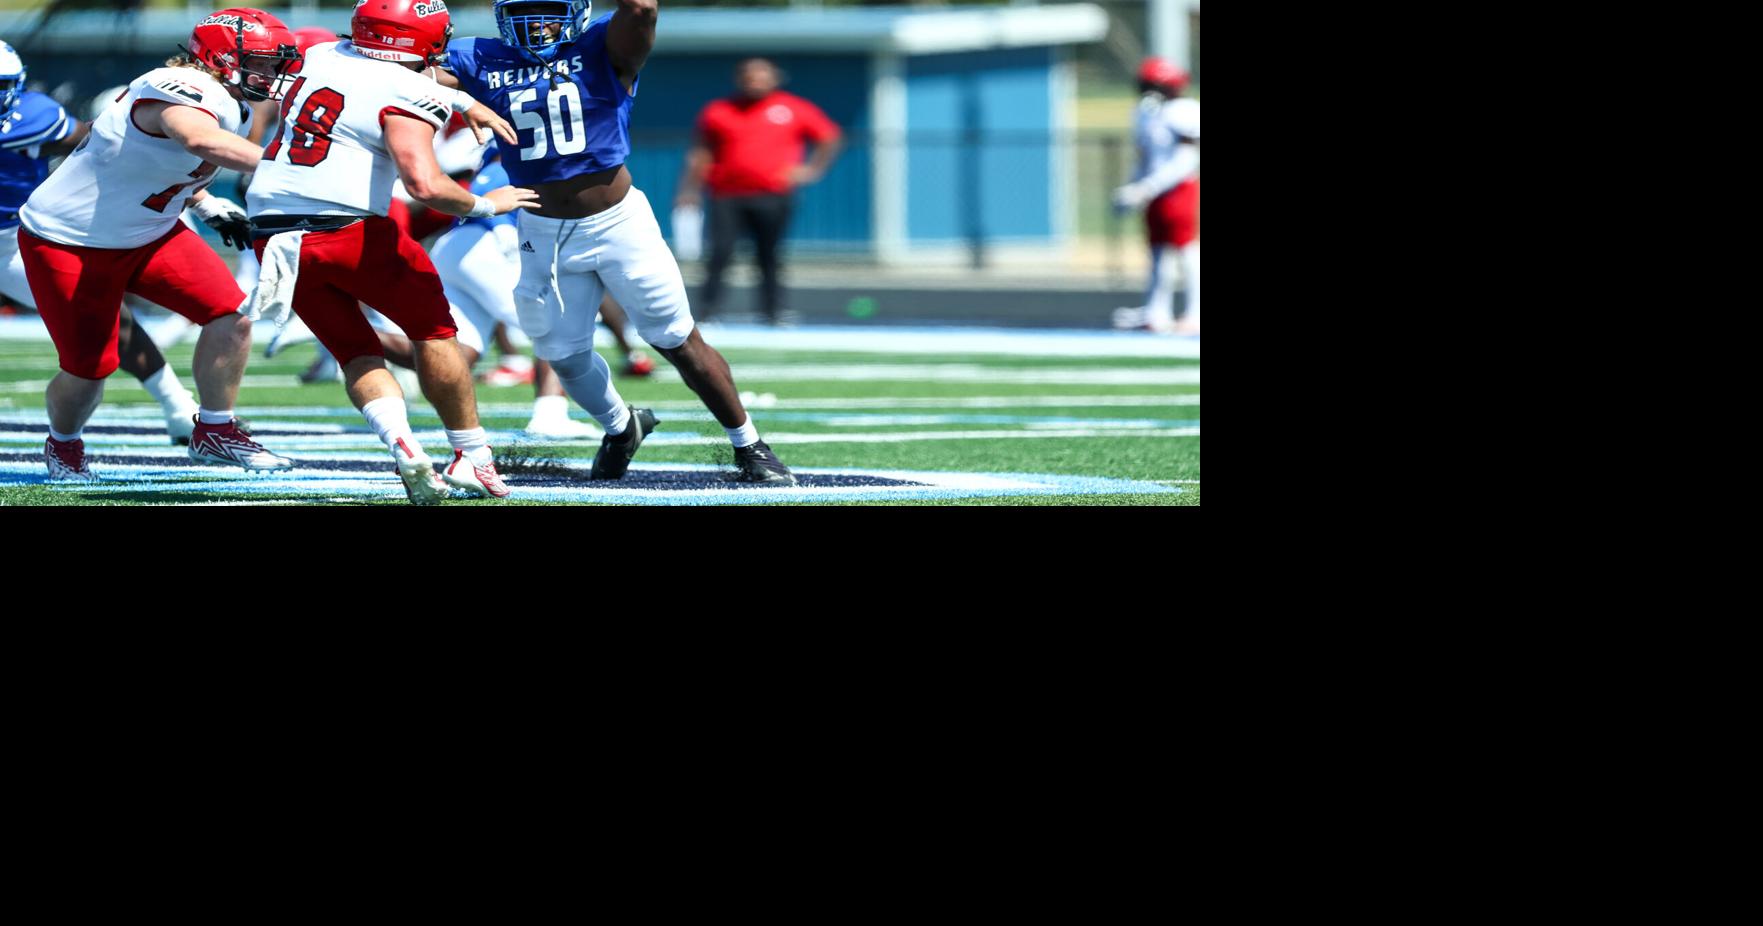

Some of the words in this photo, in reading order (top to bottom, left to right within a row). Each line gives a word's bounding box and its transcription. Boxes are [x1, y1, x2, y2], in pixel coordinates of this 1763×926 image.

[382, 35, 394, 45] 18
[488, 56, 583, 89] REIVERS
[261, 75, 345, 168] 18
[508, 82, 586, 161] 50
